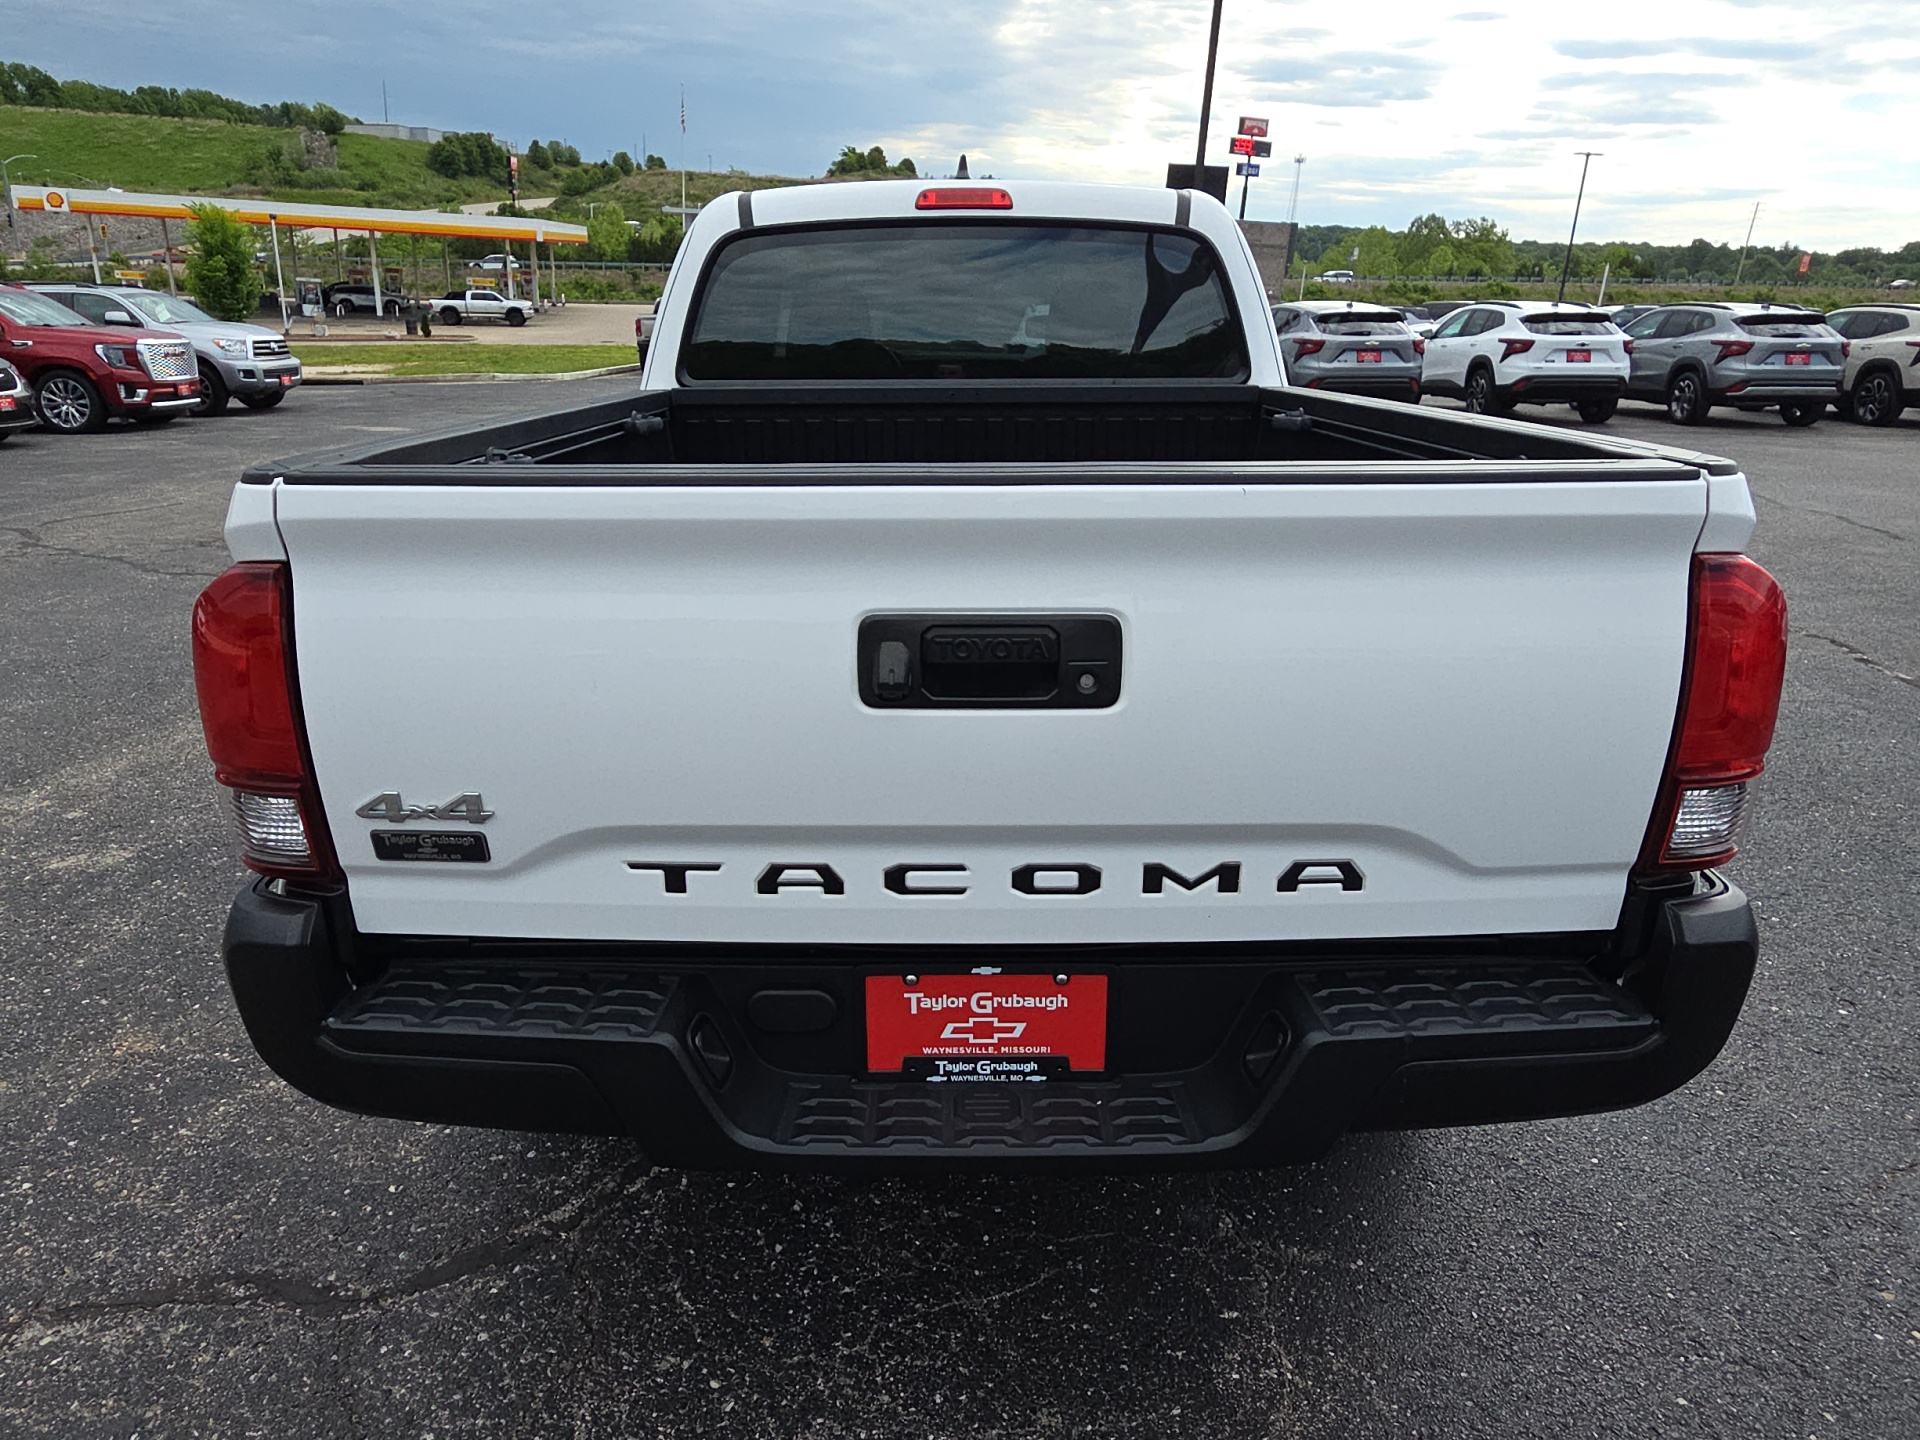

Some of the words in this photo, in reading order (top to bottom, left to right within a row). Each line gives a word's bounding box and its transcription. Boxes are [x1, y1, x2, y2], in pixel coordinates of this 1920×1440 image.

[933, 637, 1049, 660] TOYOTA
[355, 790, 495, 824] 4x4
[379, 833, 417, 846] Taylor
[418, 833, 475, 847] Grubaugh
[626, 858, 1367, 896] TACOMA
[904, 992, 967, 1014] Taylor
[970, 992, 1068, 1014] Grubaugh
[922, 1046, 998, 1054] WAYNESVILLE,
[1001, 1046, 1051, 1054] MISSOURI
[934, 1061, 975, 1075] Taylor
[976, 1060, 1038, 1074] Grubaugh
